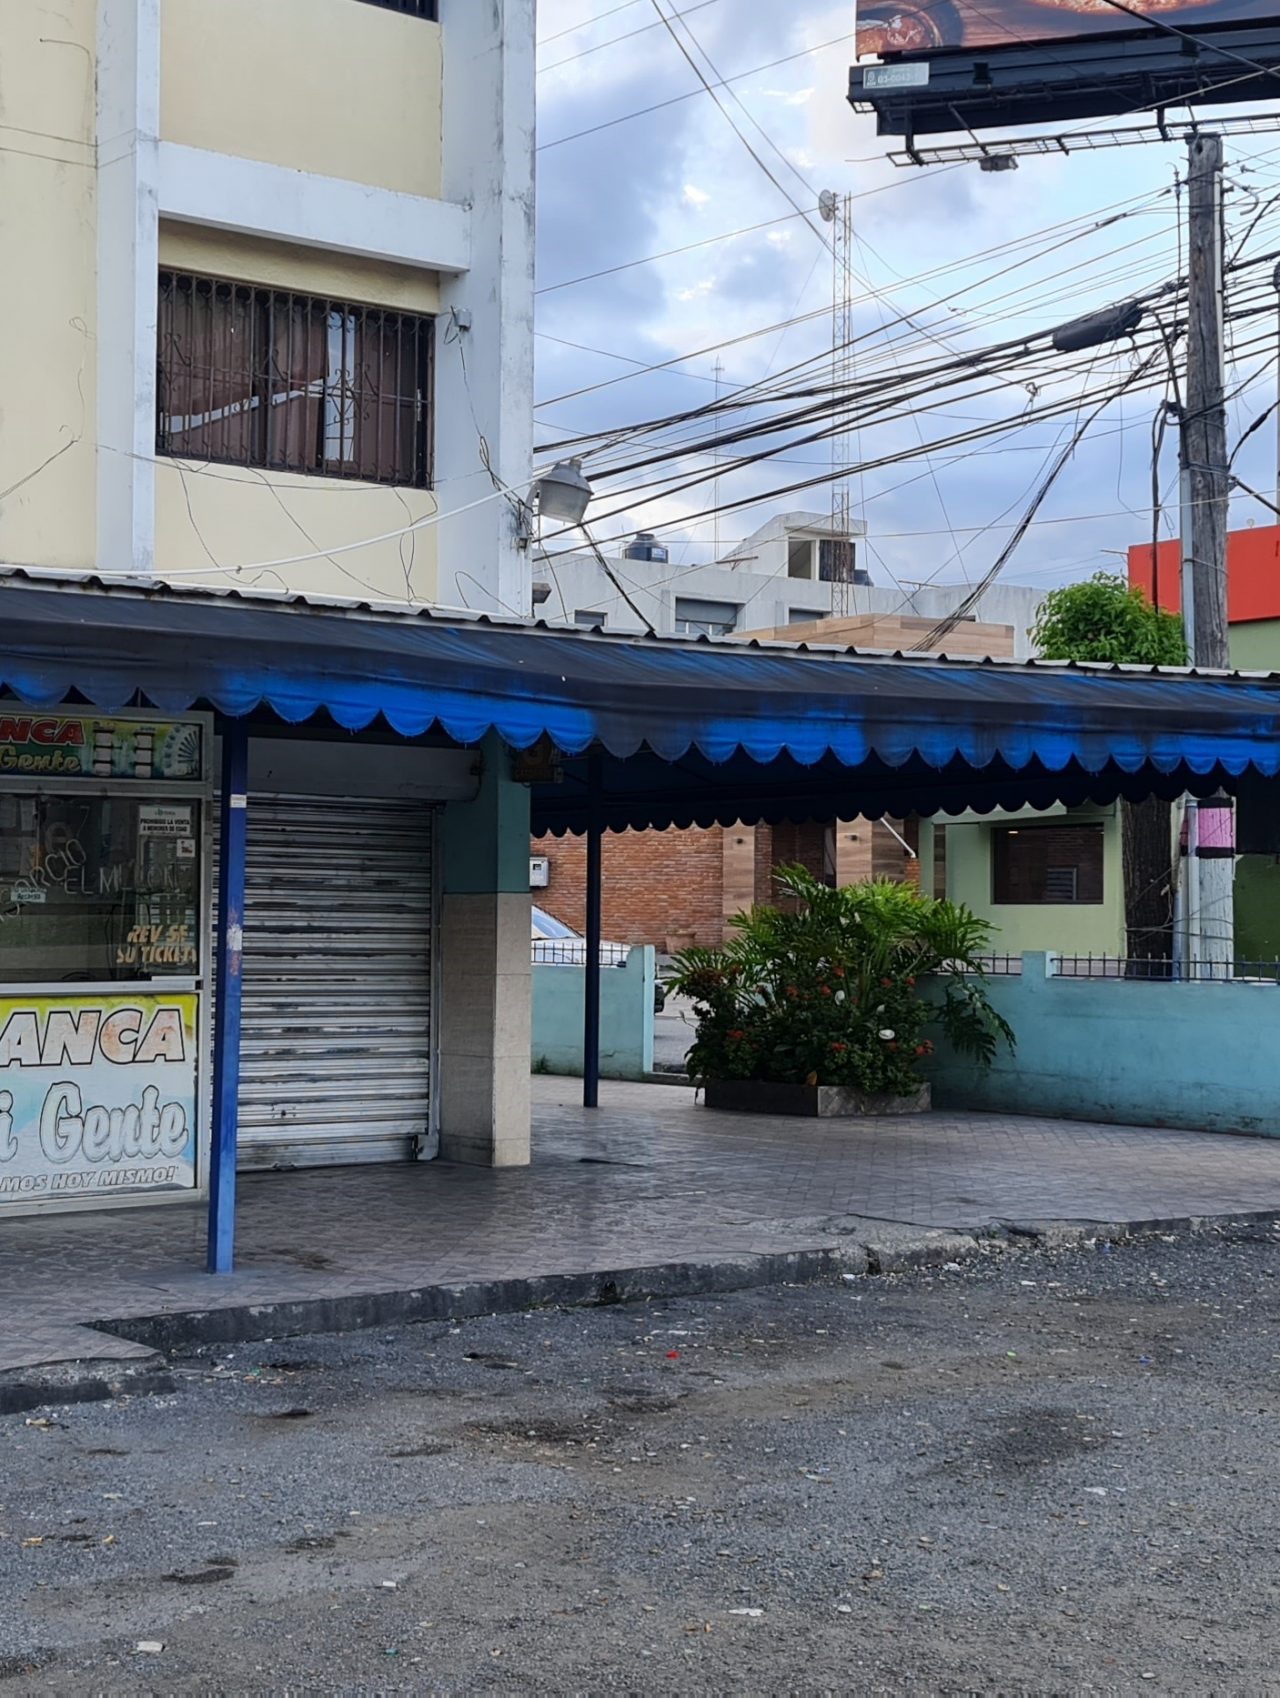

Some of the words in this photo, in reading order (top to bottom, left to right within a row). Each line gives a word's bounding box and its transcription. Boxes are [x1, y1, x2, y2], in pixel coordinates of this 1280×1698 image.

[127, 924, 189, 943] REVSE
[39, 1081, 189, 1164] Gente
[50, 1171, 97, 1190] HOY
[97, 1166, 176, 1187] MISMO!
